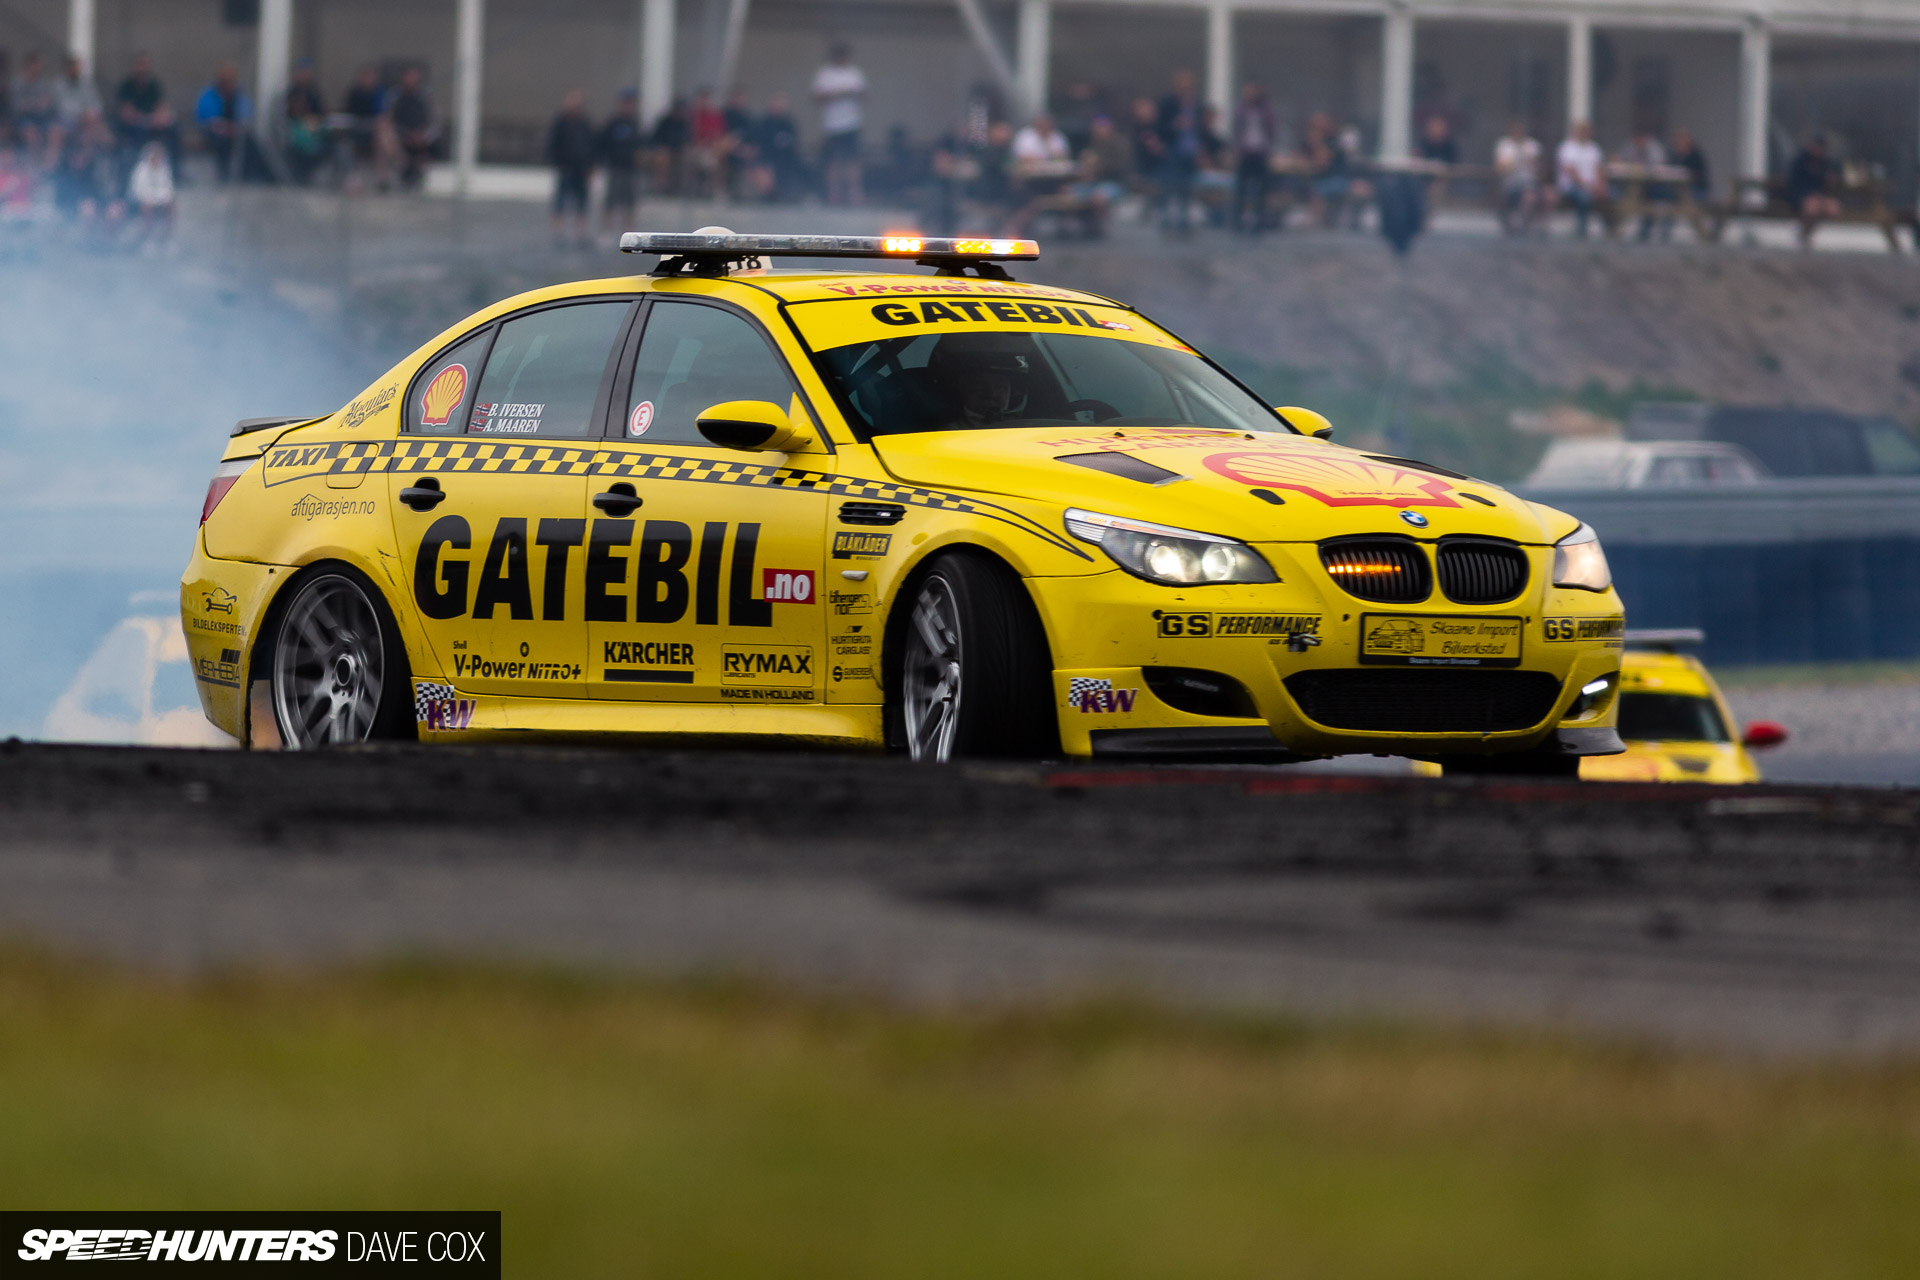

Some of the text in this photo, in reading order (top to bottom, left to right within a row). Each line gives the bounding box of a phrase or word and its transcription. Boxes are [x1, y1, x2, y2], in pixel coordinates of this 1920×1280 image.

[827, 284, 973, 296] V-Power
[871, 302, 1115, 330] GATEBIL
[487, 403, 545, 418] B. IVERSEN
[482, 418, 541, 433] A. MAAREN
[266, 447, 328, 469] TAXI
[413, 514, 811, 628] GATEBIL .no
[1162, 614, 1323, 636] GS PERFORMANCE
[1544, 619, 1574, 640] GS
[453, 640, 467, 650] Shell
[603, 641, 695, 666] KÄRCHER
[453, 653, 526, 678] V-Power
[723, 652, 812, 675] RYMAX
[720, 688, 816, 700] MADE IN HOLLAND
[1080, 688, 1140, 714] KW
[427, 699, 478, 732] KW
